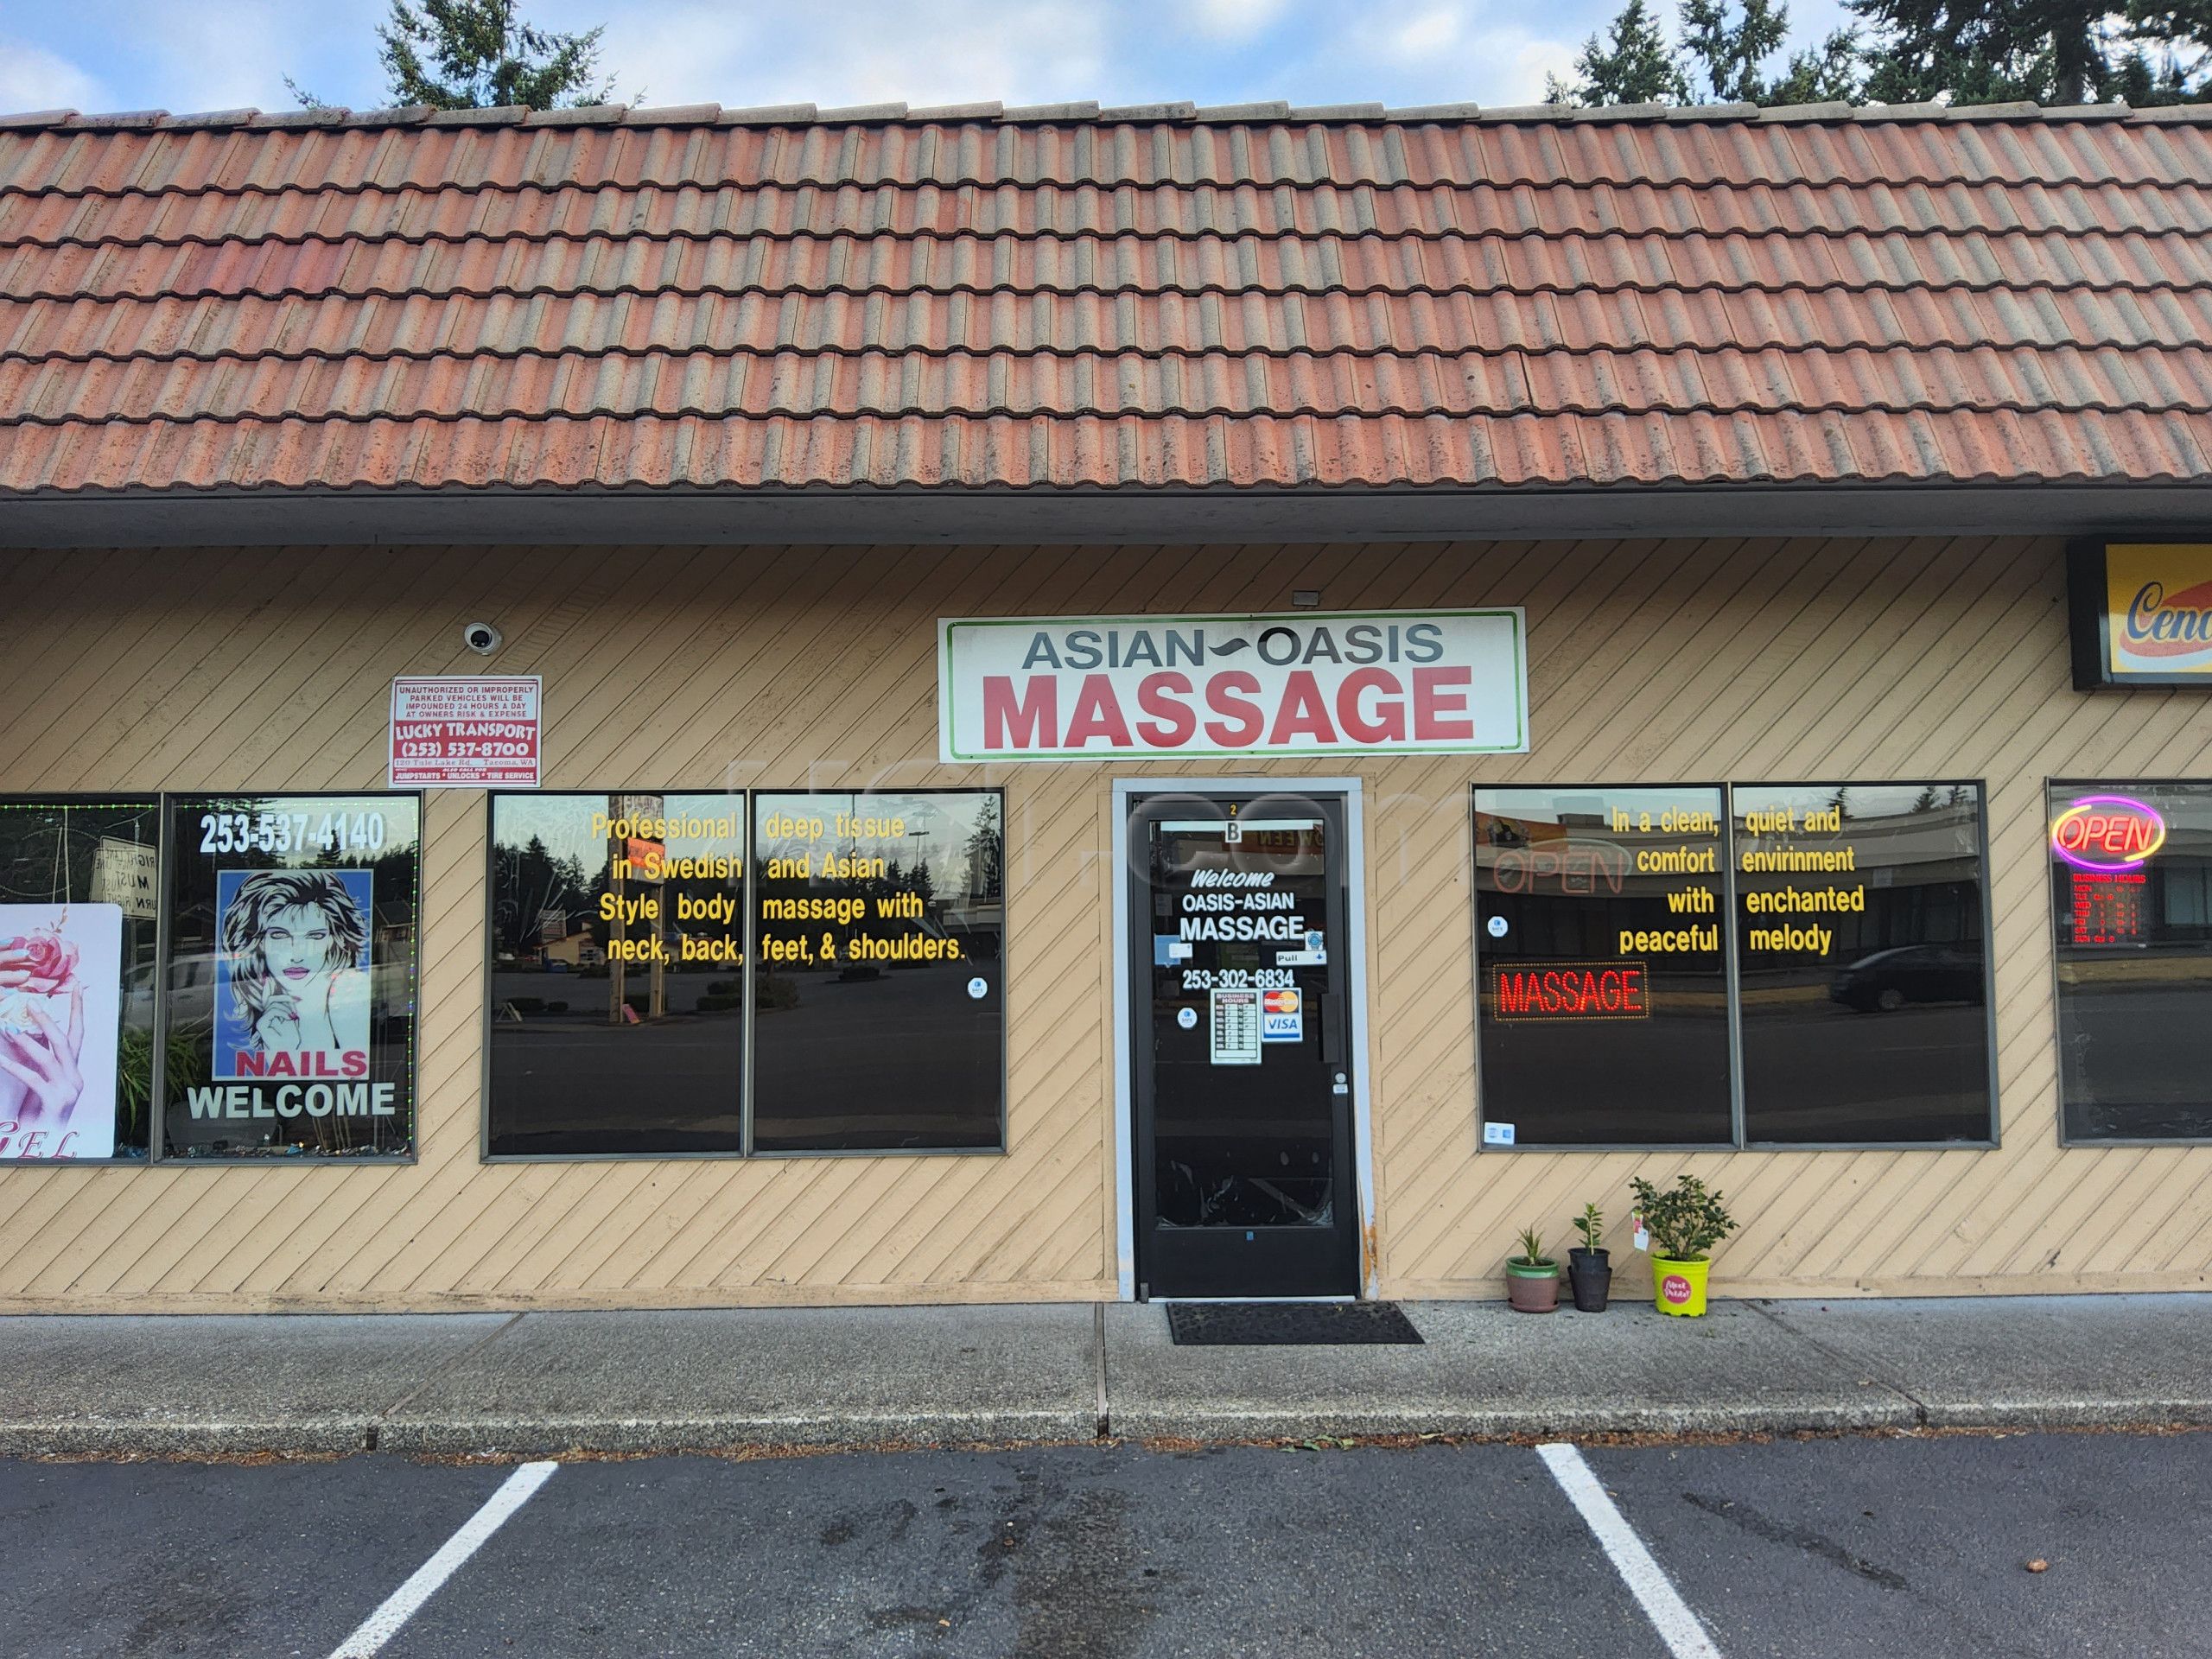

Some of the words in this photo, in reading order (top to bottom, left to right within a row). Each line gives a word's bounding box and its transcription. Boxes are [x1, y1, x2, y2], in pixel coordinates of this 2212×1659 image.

[1021, 629, 1205, 671] ASIAN
[1257, 623, 1444, 667] OASIS
[982, 665, 1474, 750] MASSAGE
[395, 723, 443, 741] LUCKY
[446, 722, 536, 741] TRANSPORT
[401, 741, 442, 757] (253)
[448, 742, 529, 756] 537-8700
[1230, 804, 1237, 815] 2
[1611, 806, 1630, 833] In
[1639, 813, 1651, 833] a
[1660, 805, 1719, 837] clean,
[1745, 805, 1795, 837] quiet
[1803, 804, 1841, 832] and
[200, 811, 385, 853] 253-537-4140
[591, 811, 737, 840] Professional
[766, 811, 823, 843] deep
[835, 811, 905, 839] tissue
[1227, 822, 1240, 842] B
[2059, 816, 2154, 853] OPEN
[612, 853, 632, 880] in
[643, 852, 742, 880] Swedish
[766, 852, 810, 880] and
[821, 852, 886, 879] Asian
[1494, 850, 1624, 894] OPEN
[1637, 846, 1715, 873] comfort
[1741, 845, 1854, 872] envirinment
[1191, 868, 1275, 888] Welcome
[599, 893, 659, 926] Style
[677, 892, 735, 925] body
[762, 896, 866, 925] massage
[876, 891, 924, 918] with
[1182, 893, 1294, 912] OASIS-ASIAN
[1668, 886, 1714, 913] with
[1745, 885, 1865, 913] enchanted
[1179, 916, 1305, 941] MASSAGE
[1618, 923, 1719, 955] peaceful
[1750, 923, 1832, 957] melody
[607, 933, 671, 965] neck,
[681, 933, 744, 964] back,
[761, 933, 814, 966] feet,
[820, 932, 836, 960] &
[849, 931, 966, 961] shoulders.
[1278, 954, 1298, 963] Pull
[1182, 969, 1294, 989] 253-302-6834
[1501, 969, 1642, 1013] MASSAGE
[1268, 1018, 1298, 1029] VISA
[235, 1051, 367, 1077] NAILS
[188, 1083, 396, 1119] WELCOME
